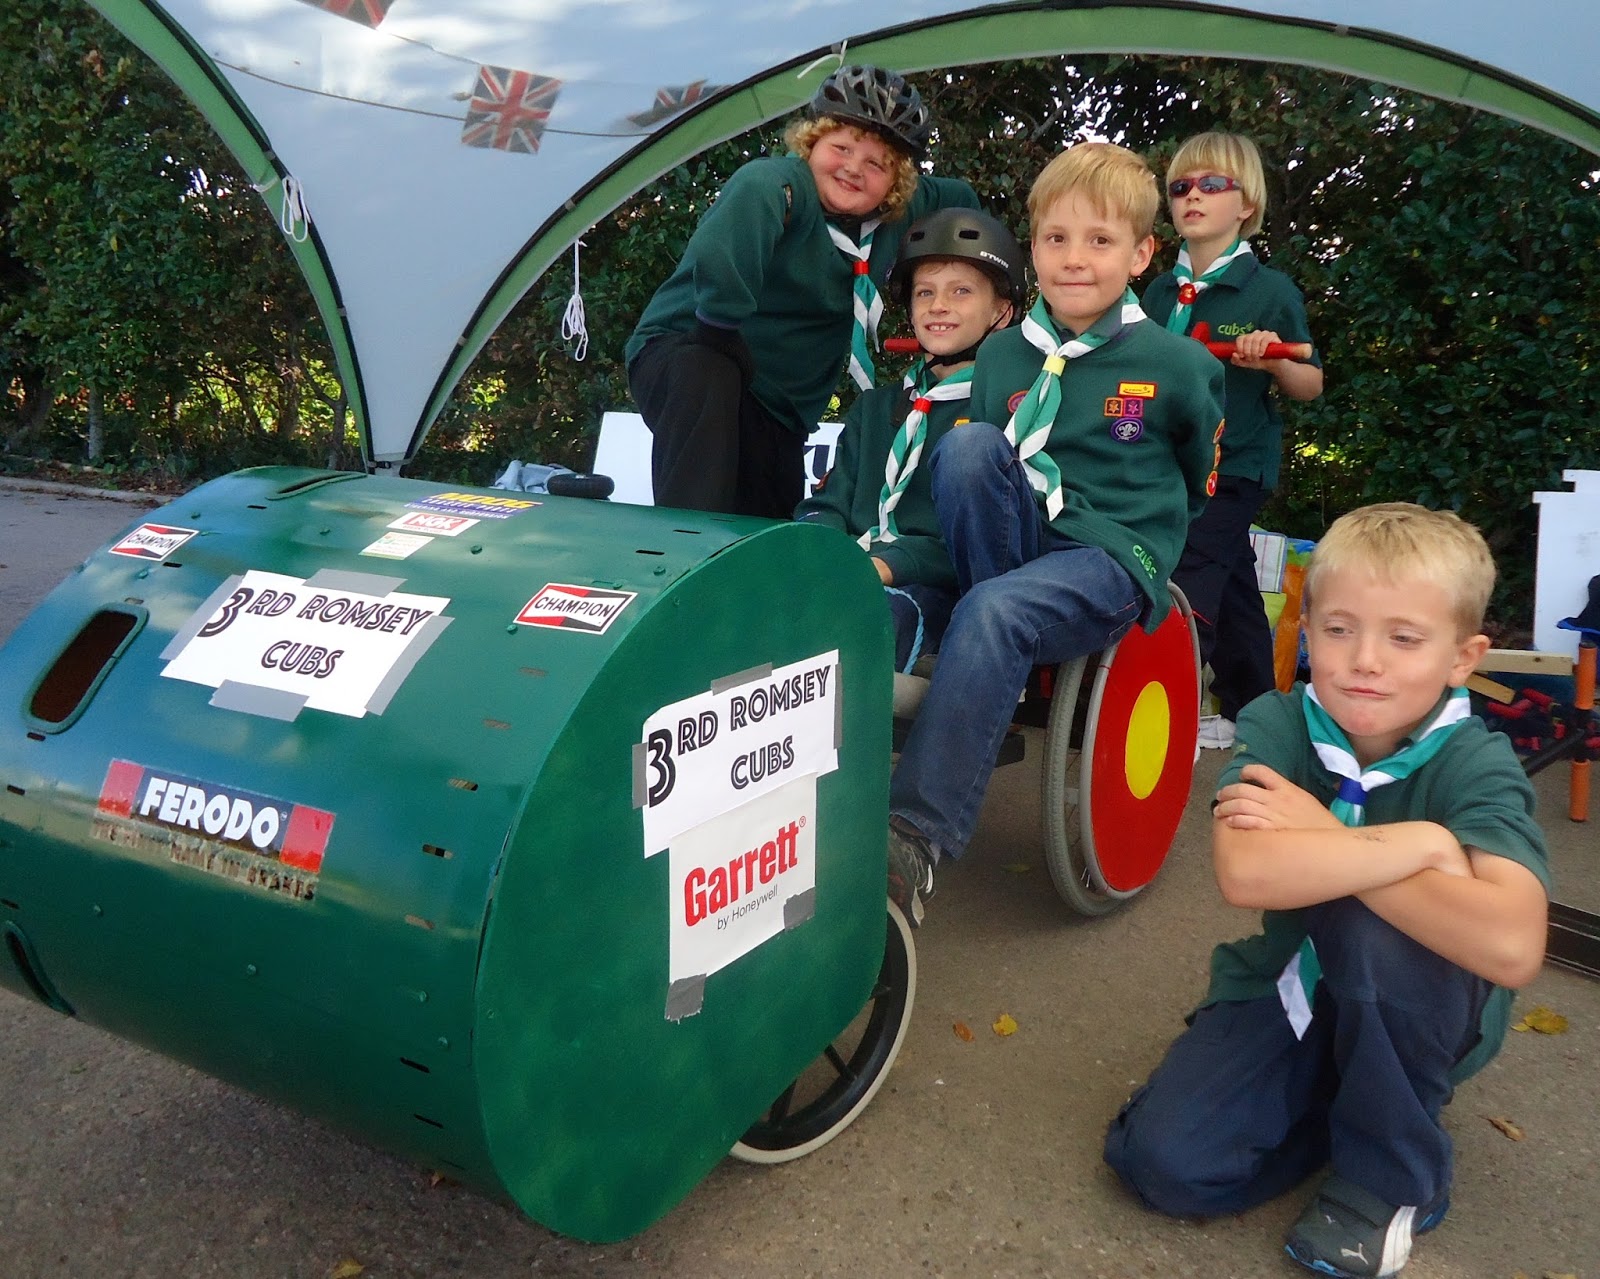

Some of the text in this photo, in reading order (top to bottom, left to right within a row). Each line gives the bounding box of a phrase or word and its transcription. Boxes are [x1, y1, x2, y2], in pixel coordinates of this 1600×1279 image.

[1217, 323, 1246, 336] cubs
[127, 533, 179, 549] CHAMPION
[408, 514, 463, 531] NGK
[1132, 544, 1157, 579] cubs
[196, 587, 434, 638] 3RD ROMSEY
[534, 596, 615, 618] CHAMPION
[260, 639, 345, 679] CUBS
[647, 665, 831, 808] 3RD ROMSEY
[730, 735, 795, 790] CUBS
[139, 777, 280, 848] FERODO
[684, 820, 800, 927] Garrett
[717, 884, 778, 930] by Honeywell
